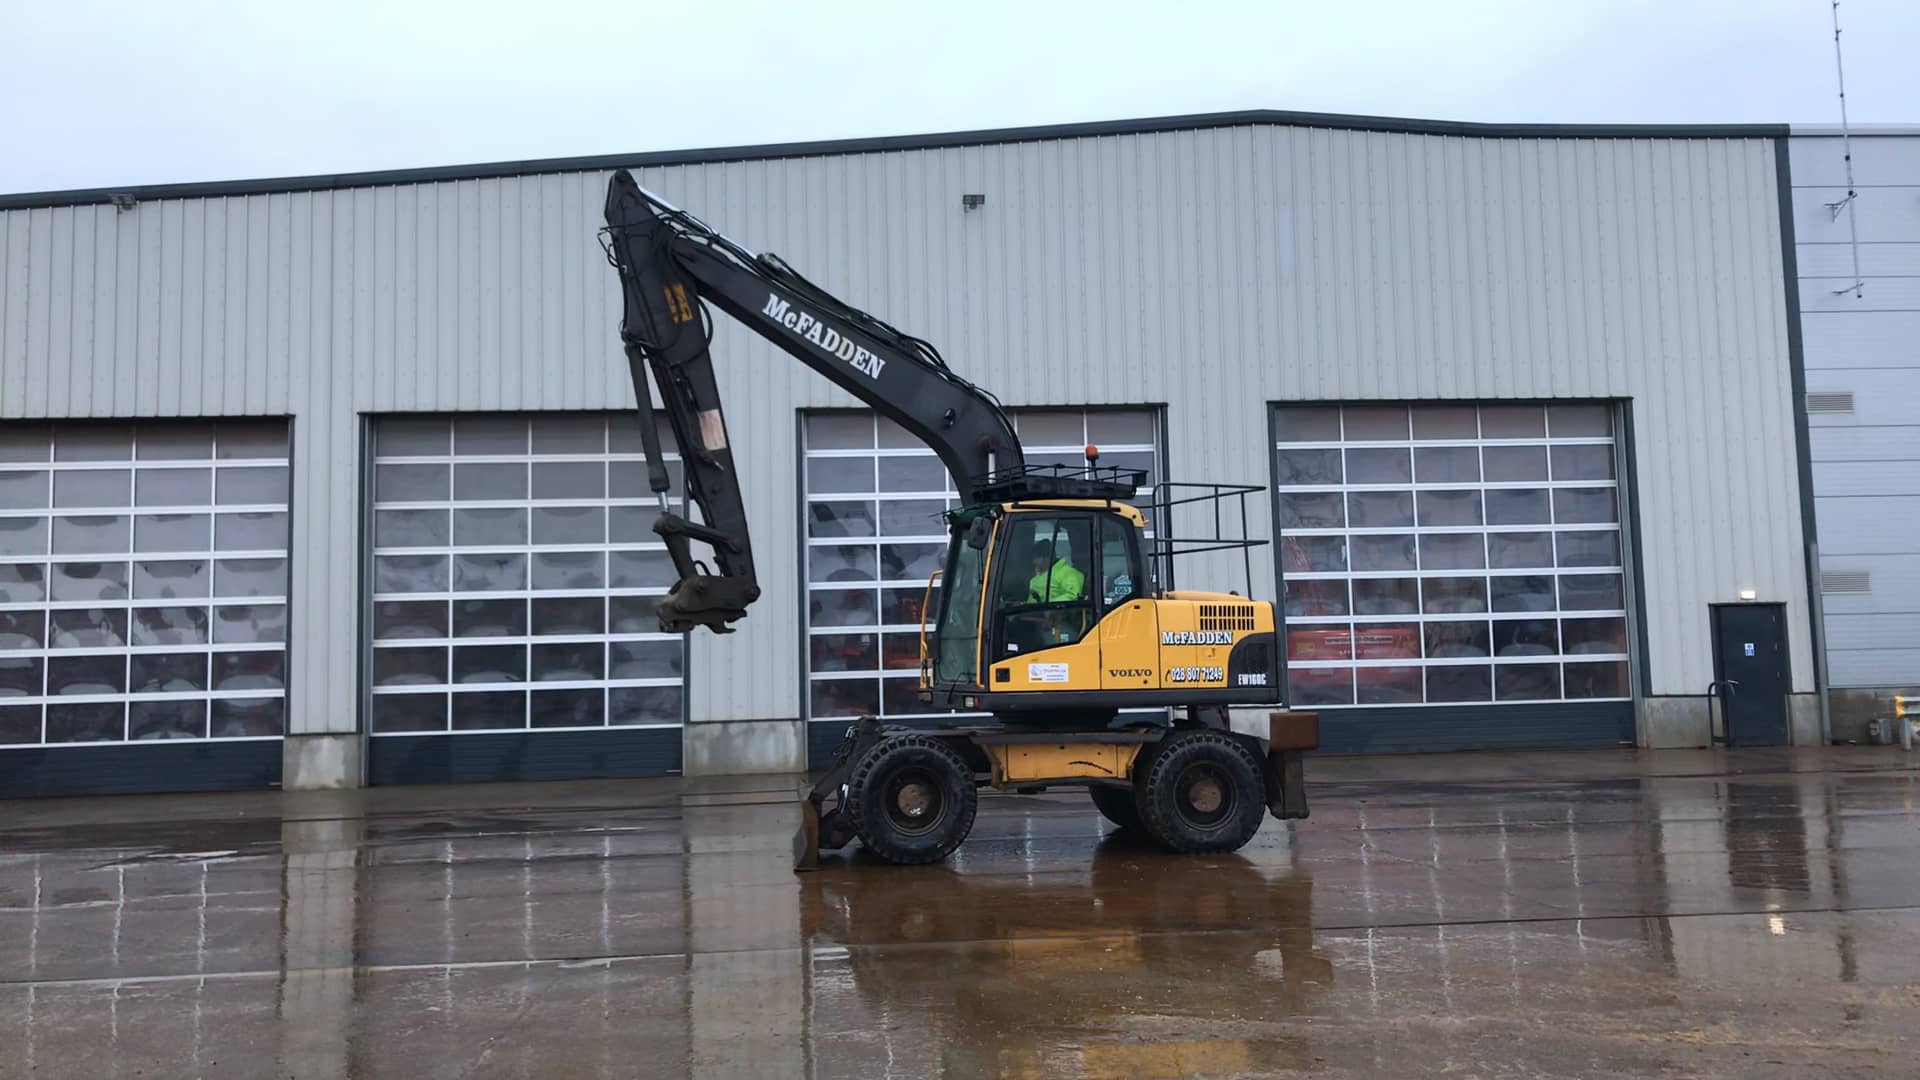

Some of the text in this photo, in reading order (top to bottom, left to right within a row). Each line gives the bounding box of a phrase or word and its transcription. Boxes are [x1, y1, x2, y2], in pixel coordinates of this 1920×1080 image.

[762, 293, 886, 380] McFADDEN
[1162, 631, 1233, 646] McFADDEN
[1108, 669, 1152, 677] VOLVO
[1171, 667, 1186, 682] 028
[1201, 667, 1224, 682] 71249
